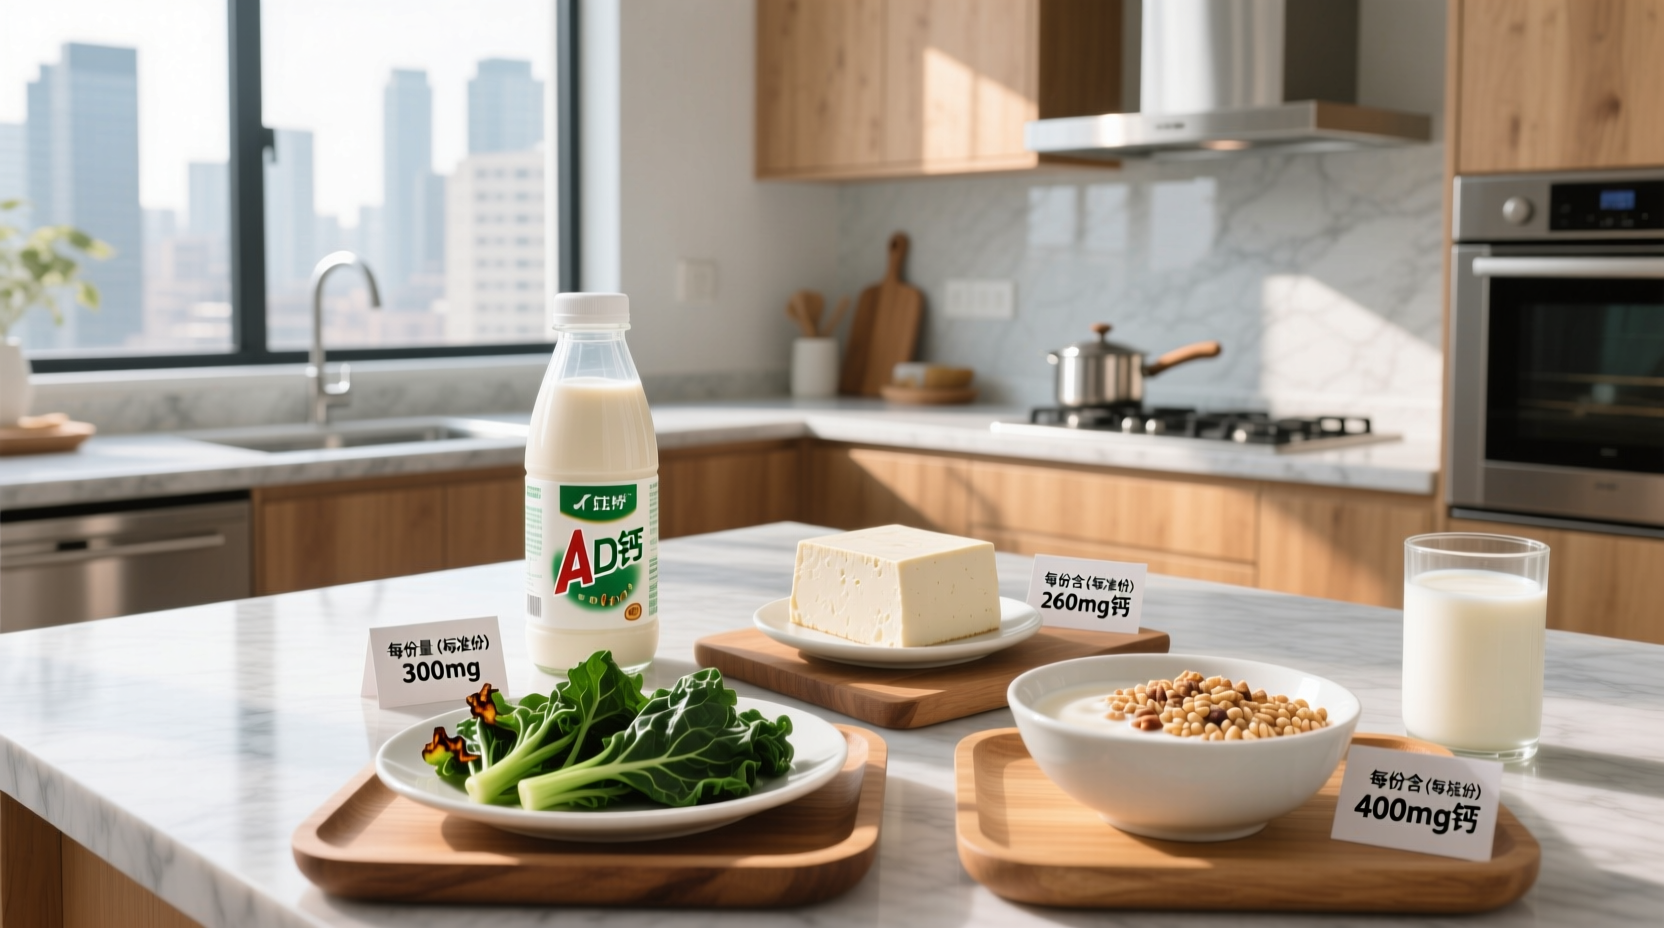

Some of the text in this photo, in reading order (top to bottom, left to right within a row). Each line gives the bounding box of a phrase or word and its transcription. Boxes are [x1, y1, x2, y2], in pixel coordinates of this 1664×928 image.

[554, 526, 644, 595] AD钙
[1040, 591, 1131, 619] 260mg钙
[402, 660, 481, 683] 300mg
[1354, 794, 1481, 835] 400mg钙
